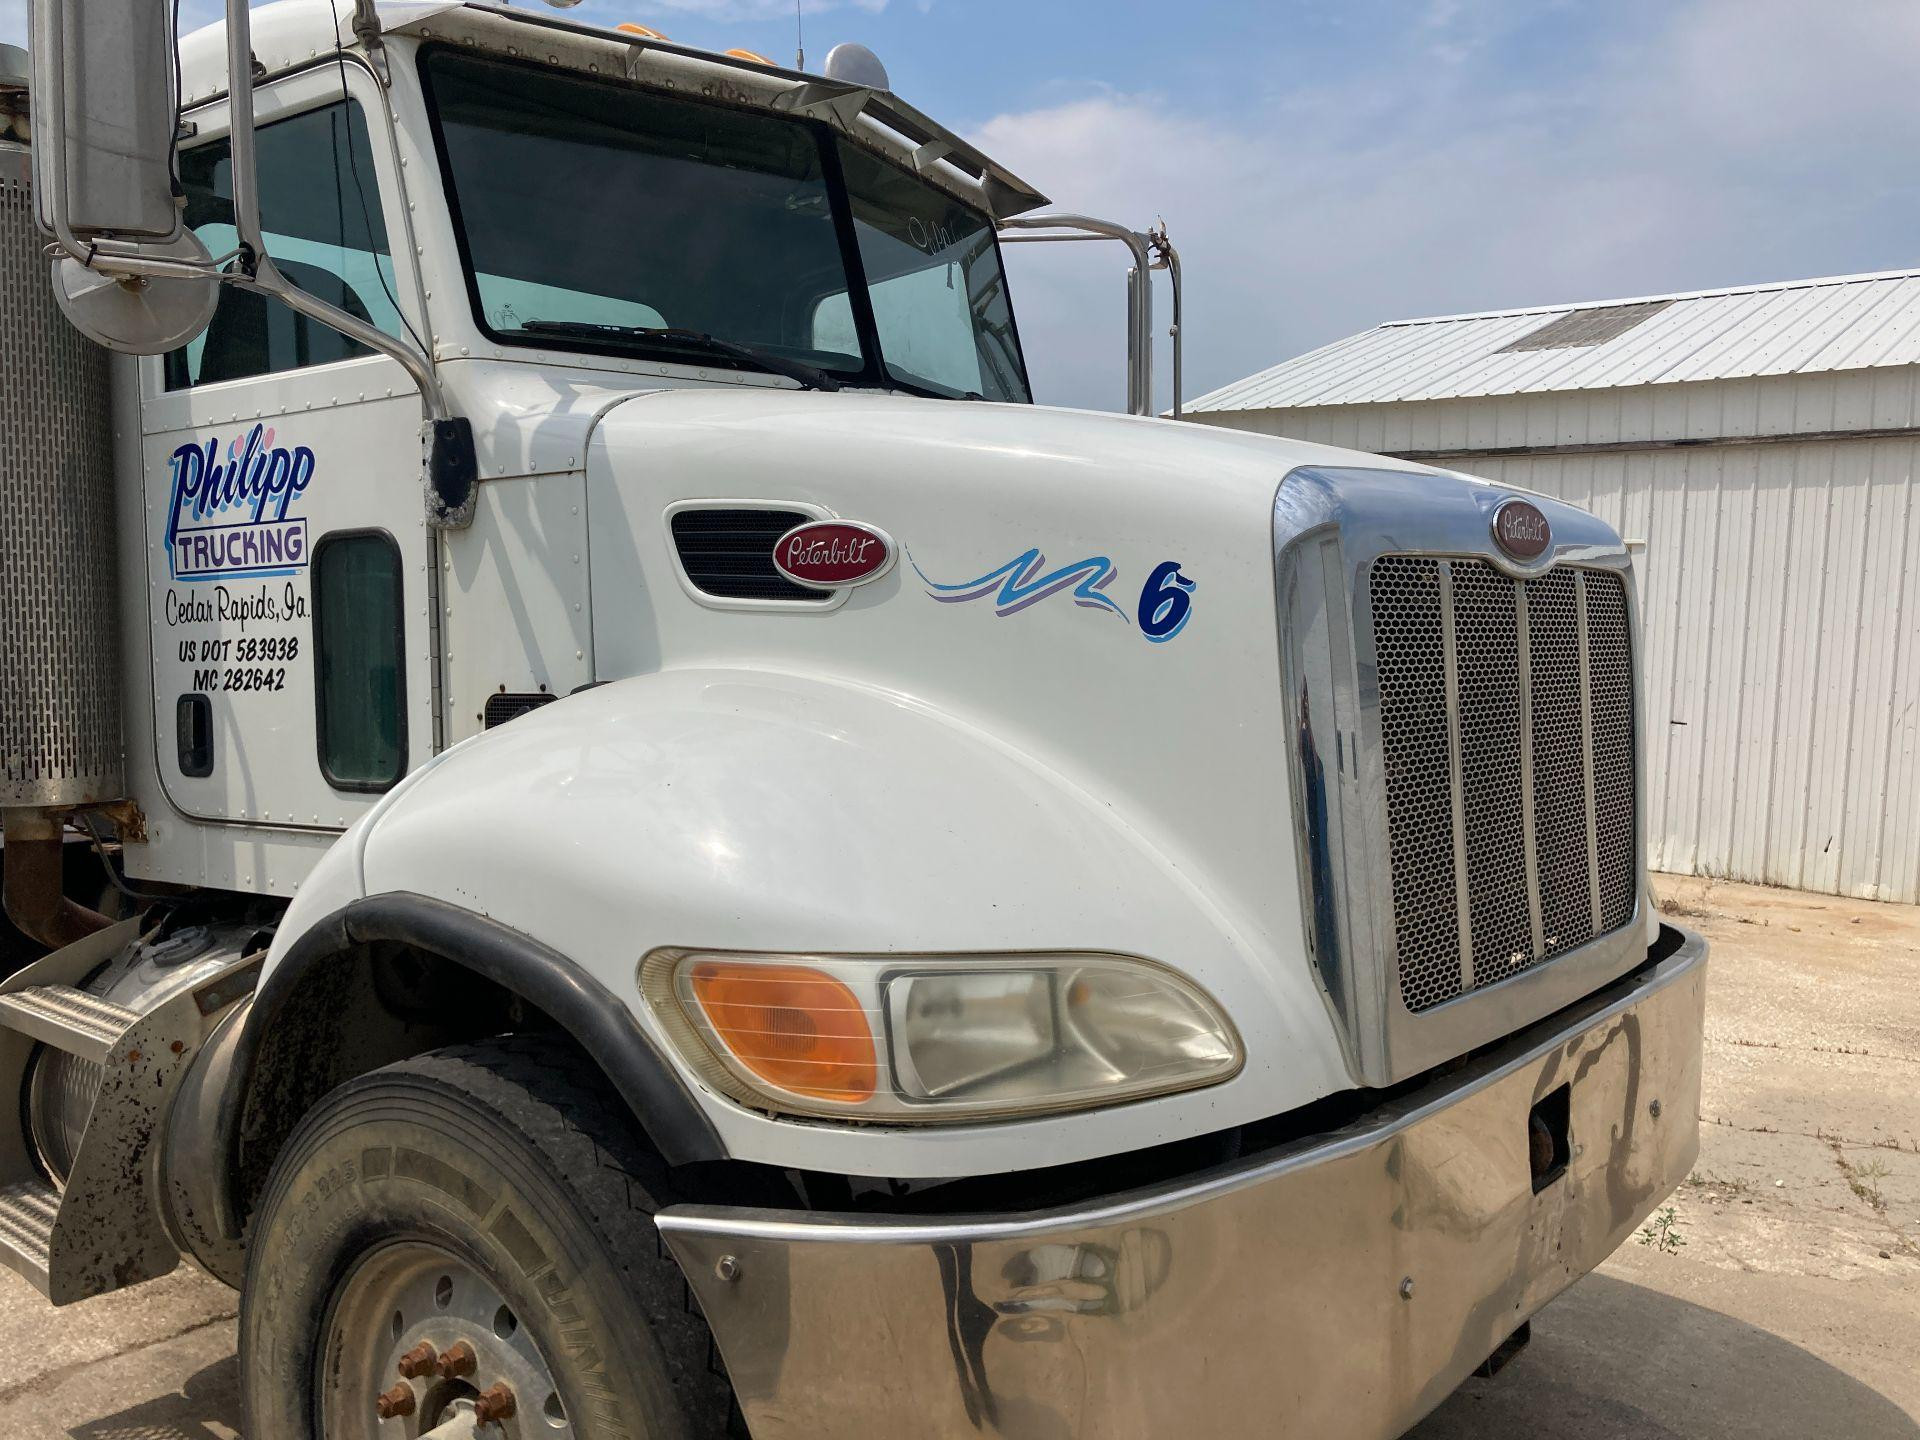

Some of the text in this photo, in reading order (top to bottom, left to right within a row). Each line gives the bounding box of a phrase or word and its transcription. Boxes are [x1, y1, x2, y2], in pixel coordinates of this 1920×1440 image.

[167, 422, 316, 546] Philipp
[1504, 510, 1546, 541] Peterbilt
[178, 525, 303, 570] TRUCKING
[786, 536, 876, 569] Peterbilt
[165, 588, 213, 627] Cedar
[1137, 560, 1197, 643] 6
[179, 636, 299, 662] US DOT 583938
[193, 666, 286, 692] MC 282642
